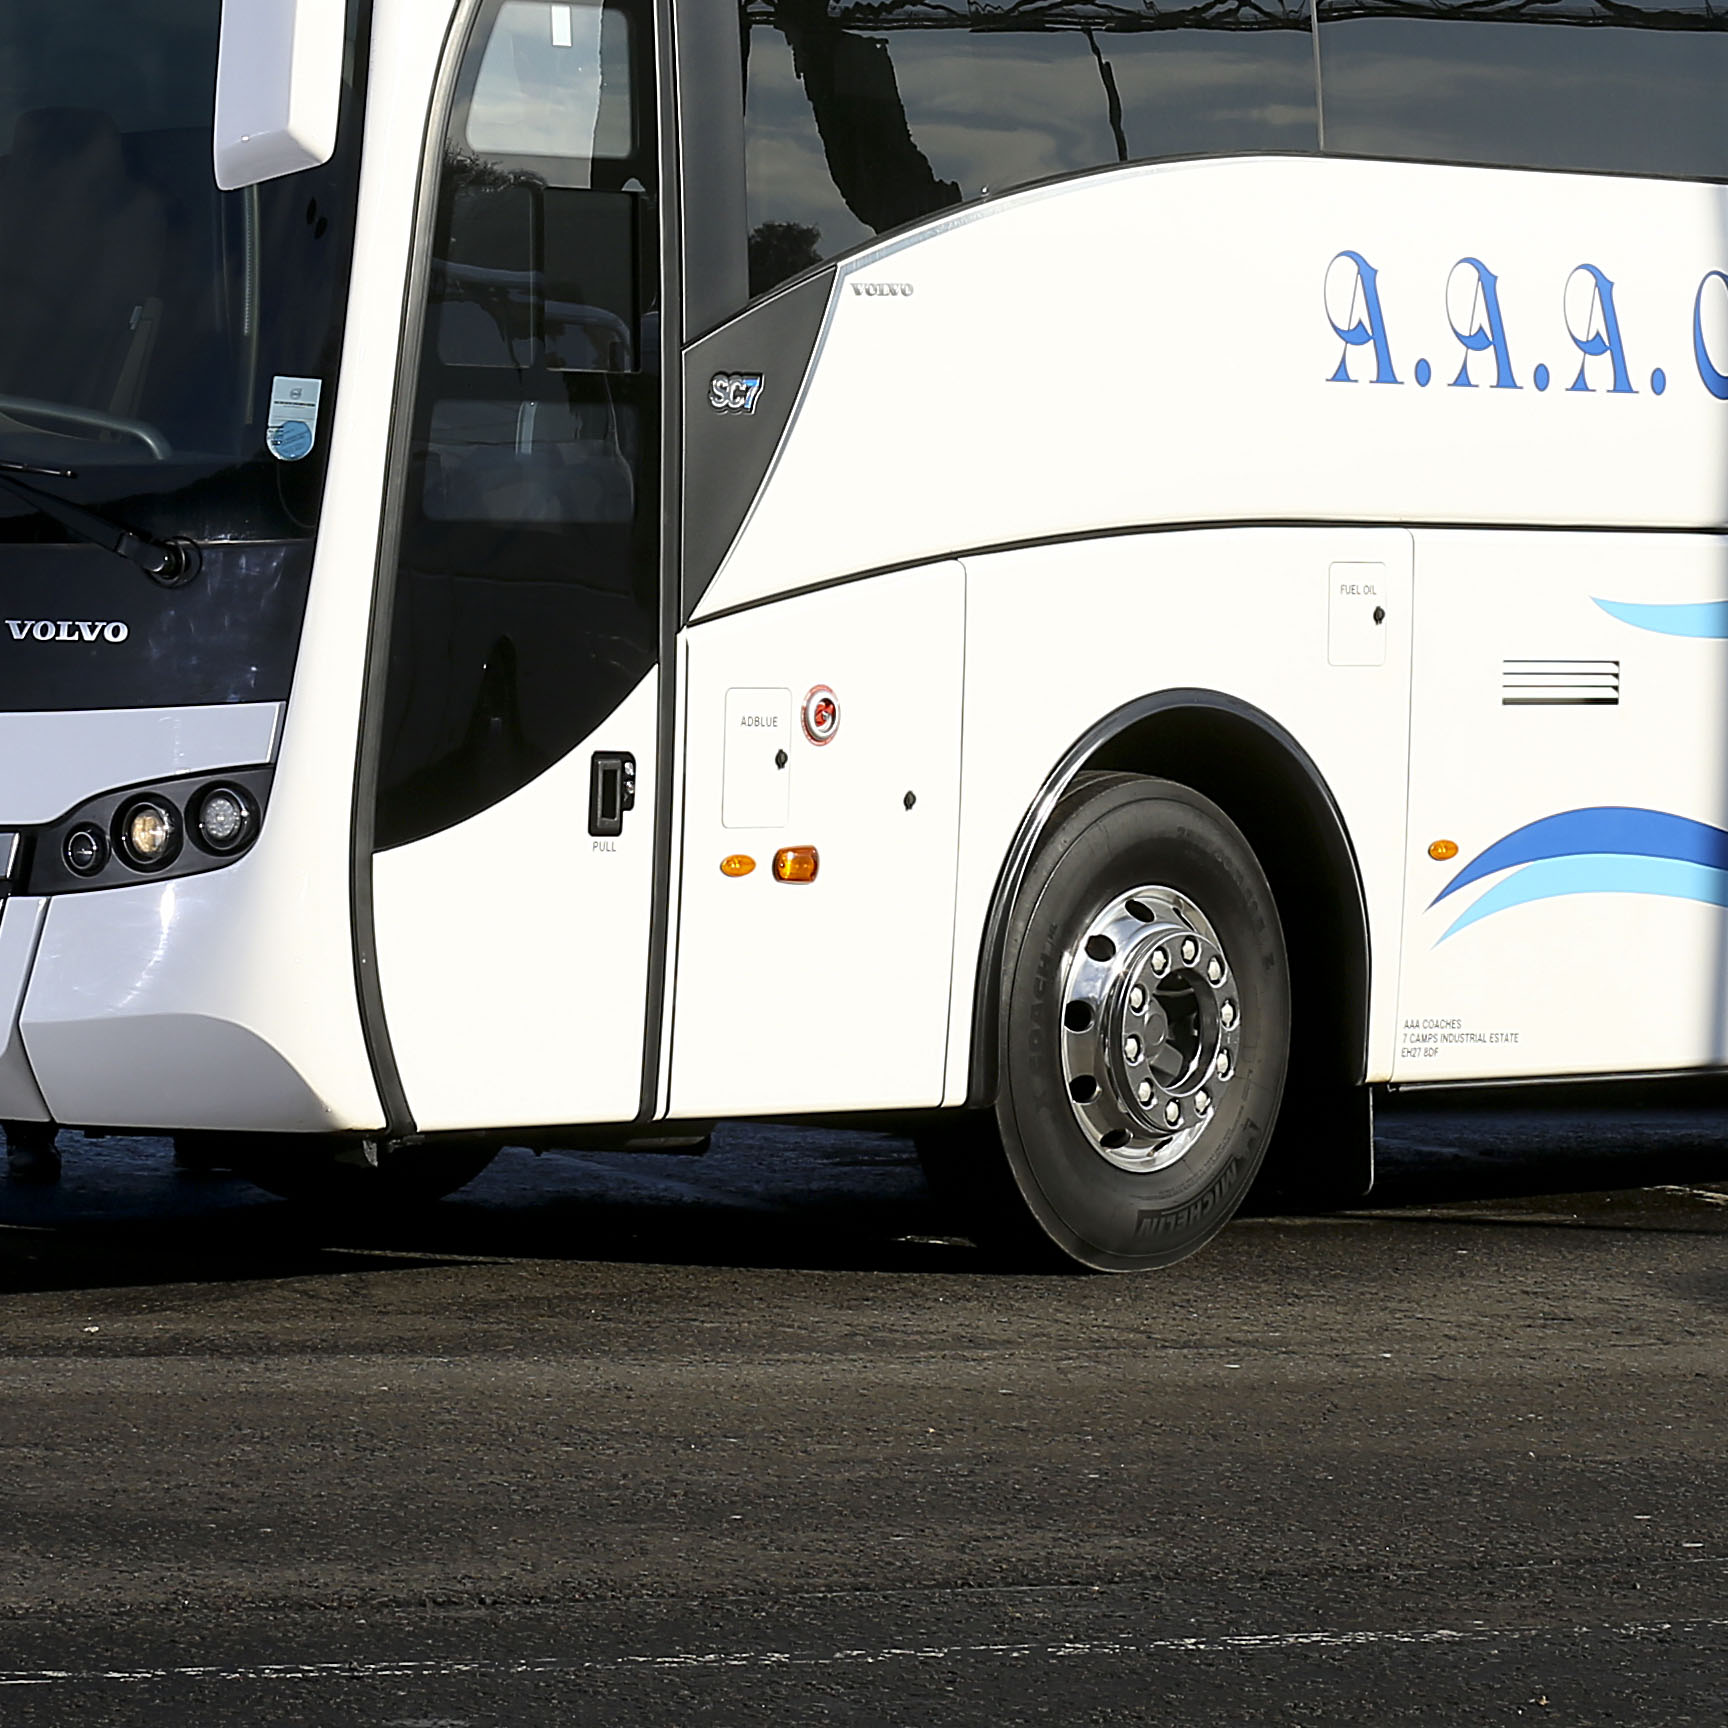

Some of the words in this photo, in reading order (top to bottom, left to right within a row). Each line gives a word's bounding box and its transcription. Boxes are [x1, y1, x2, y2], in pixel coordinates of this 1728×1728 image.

[849, 283, 914, 297] VOLVO
[1323, 250, 1667, 396] A.A.A.
[710, 374, 761, 410] SC7
[1340, 584, 1361, 595] FUEL
[1363, 584, 1377, 595] OIL
[5, 619, 129, 642] VOLVO
[740, 716, 778, 727] ADBLUE
[1403, 1019, 1420, 1029] AAA
[1422, 1019, 1462, 1030] COACHES
[1402, 1033, 1408, 1043] 7
[1409, 1033, 1438, 1043] CAMPS
[1440, 1033, 1486, 1043] INDUSTRIAL
[1489, 1033, 1519, 1043] ESTATE
[1401, 1047, 1421, 1057] EH27
